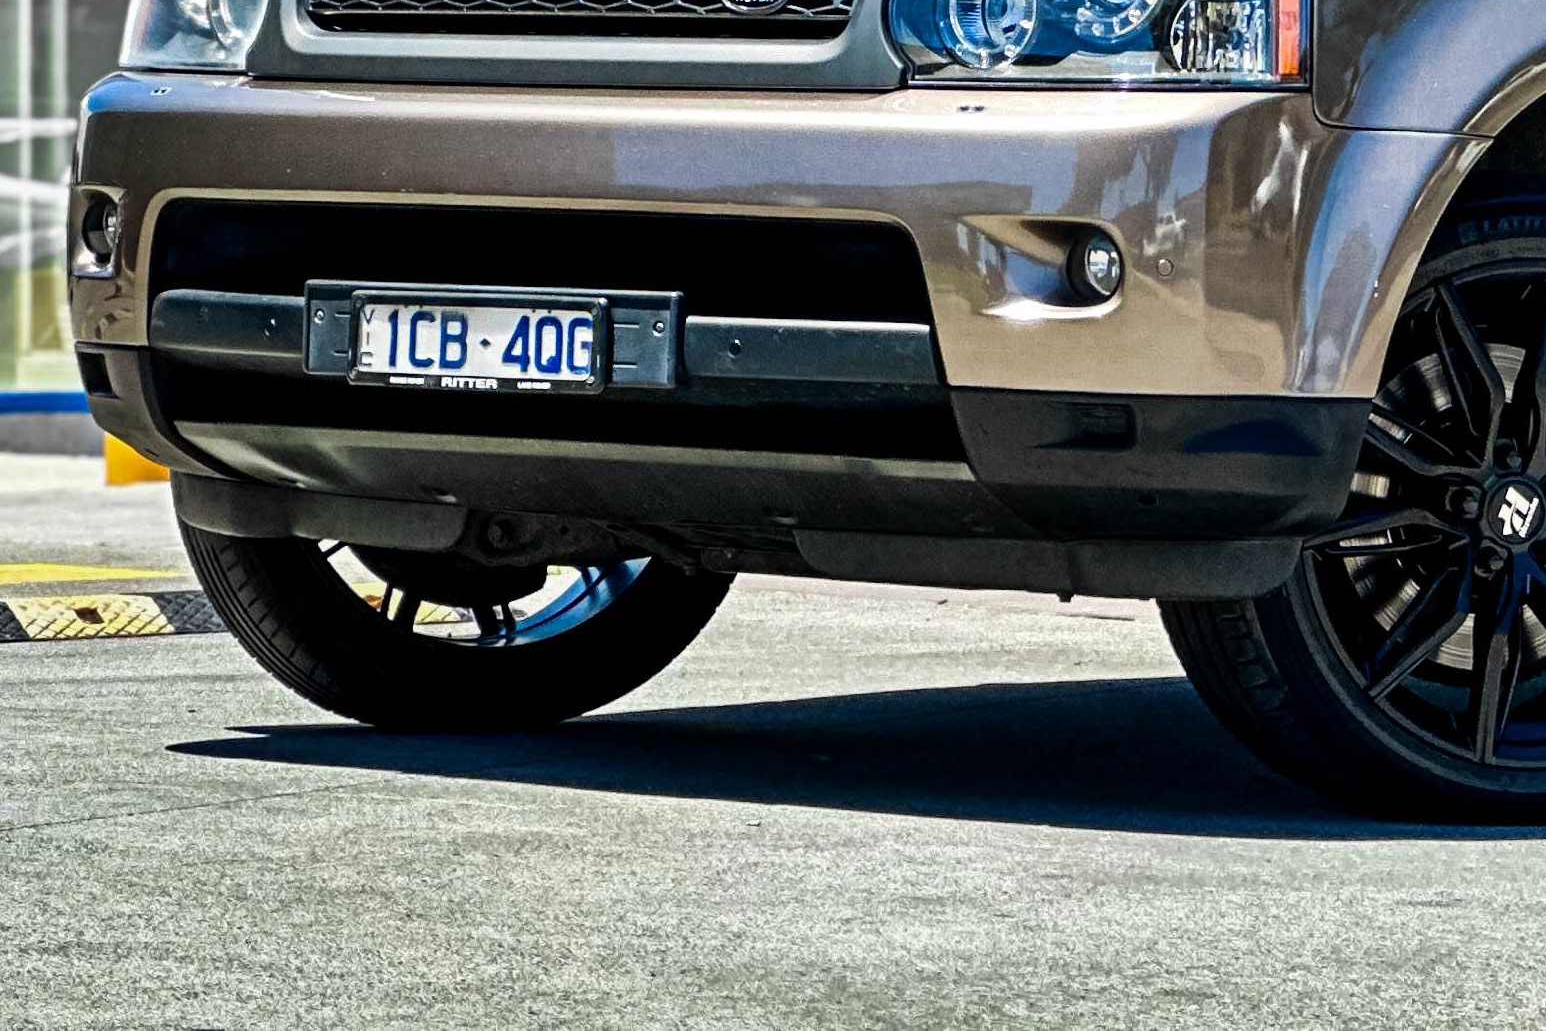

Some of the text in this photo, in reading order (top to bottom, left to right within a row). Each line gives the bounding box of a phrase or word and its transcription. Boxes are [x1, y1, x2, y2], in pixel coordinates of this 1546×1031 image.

[359, 307, 376, 368] VIC
[387, 308, 469, 370] 1CB
[440, 376, 498, 390] RITTER
